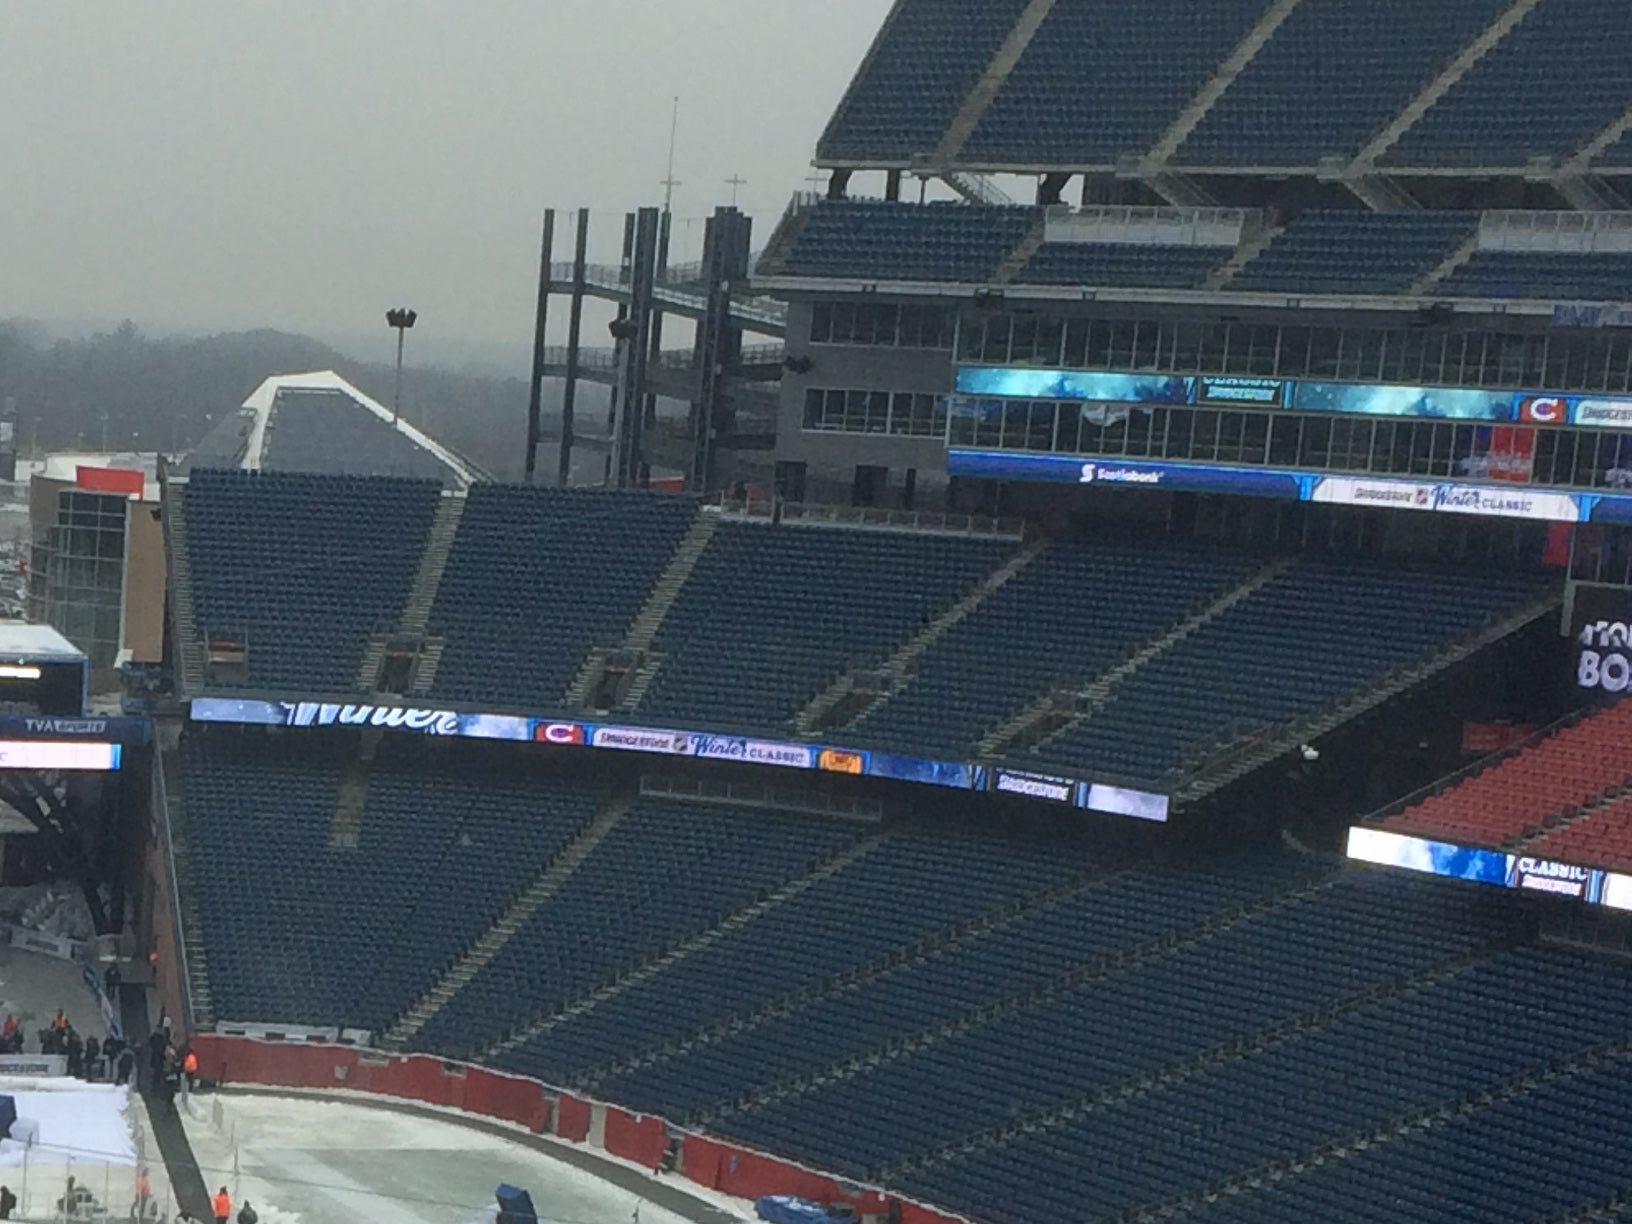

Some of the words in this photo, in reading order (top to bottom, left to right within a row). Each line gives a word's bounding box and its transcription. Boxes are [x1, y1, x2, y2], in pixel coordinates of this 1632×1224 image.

[1431, 483, 1482, 510] Winter
[1482, 498, 1532, 512] CLASSIC
[1577, 650, 1632, 692] BO
[690, 734, 747, 758] Winter
[749, 748, 806, 764] CLASSIC
[1518, 857, 1588, 880] CLASSIC
